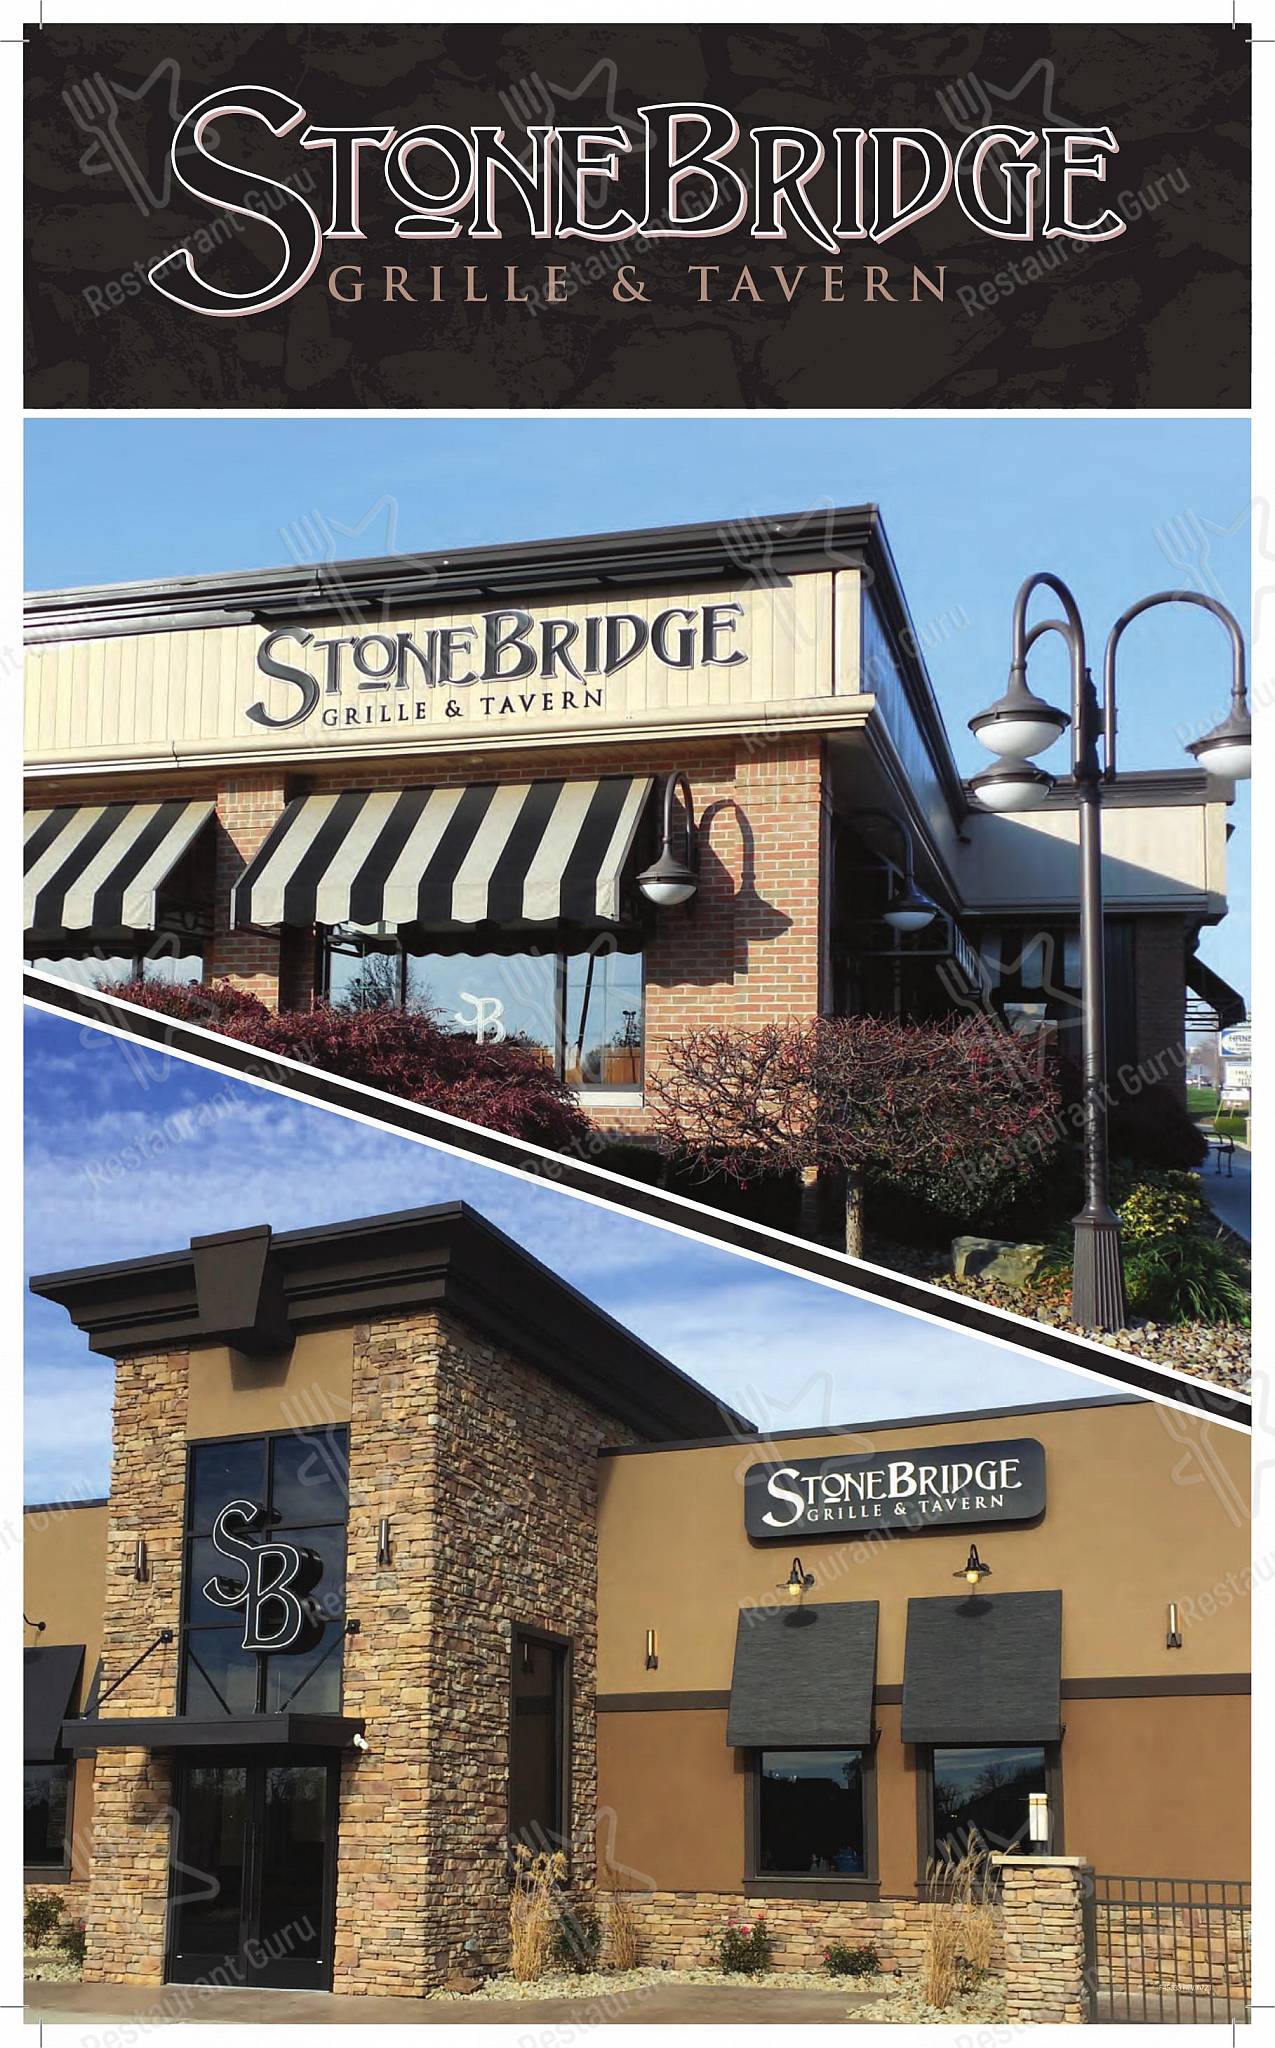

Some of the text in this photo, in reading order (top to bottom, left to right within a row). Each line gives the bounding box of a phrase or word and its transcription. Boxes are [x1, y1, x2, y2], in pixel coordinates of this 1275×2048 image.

[328, 265, 948, 303] GRILLE & TAVERN
[322, 688, 604, 727] GRILLE & TAVERN
[806, 1494, 1005, 1522] GRILLE & TAVERN
